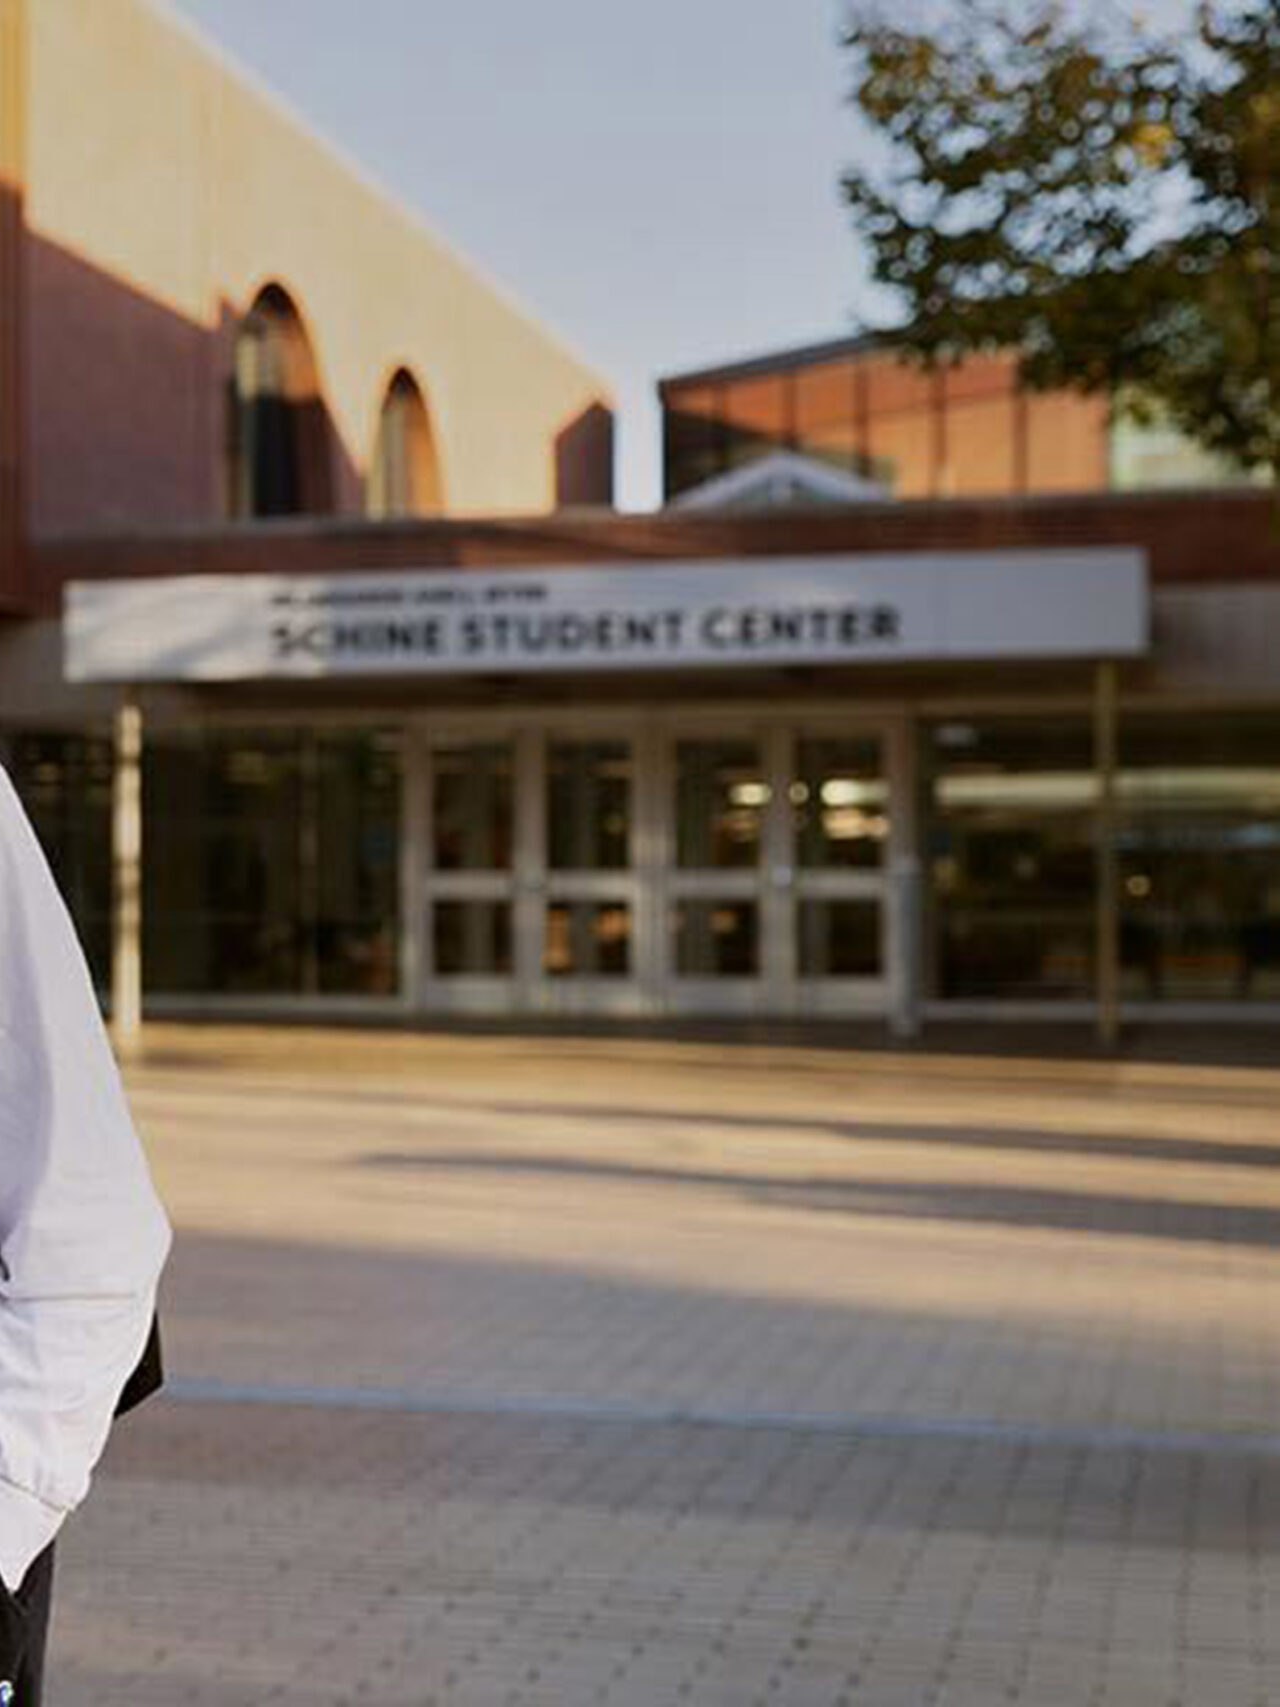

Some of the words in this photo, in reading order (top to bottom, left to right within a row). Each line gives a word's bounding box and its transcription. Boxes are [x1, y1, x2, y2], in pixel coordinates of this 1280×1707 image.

[272, 614, 439, 656] SCHINE
[463, 609, 682, 653] STUDENT
[699, 605, 901, 649] CENTER
